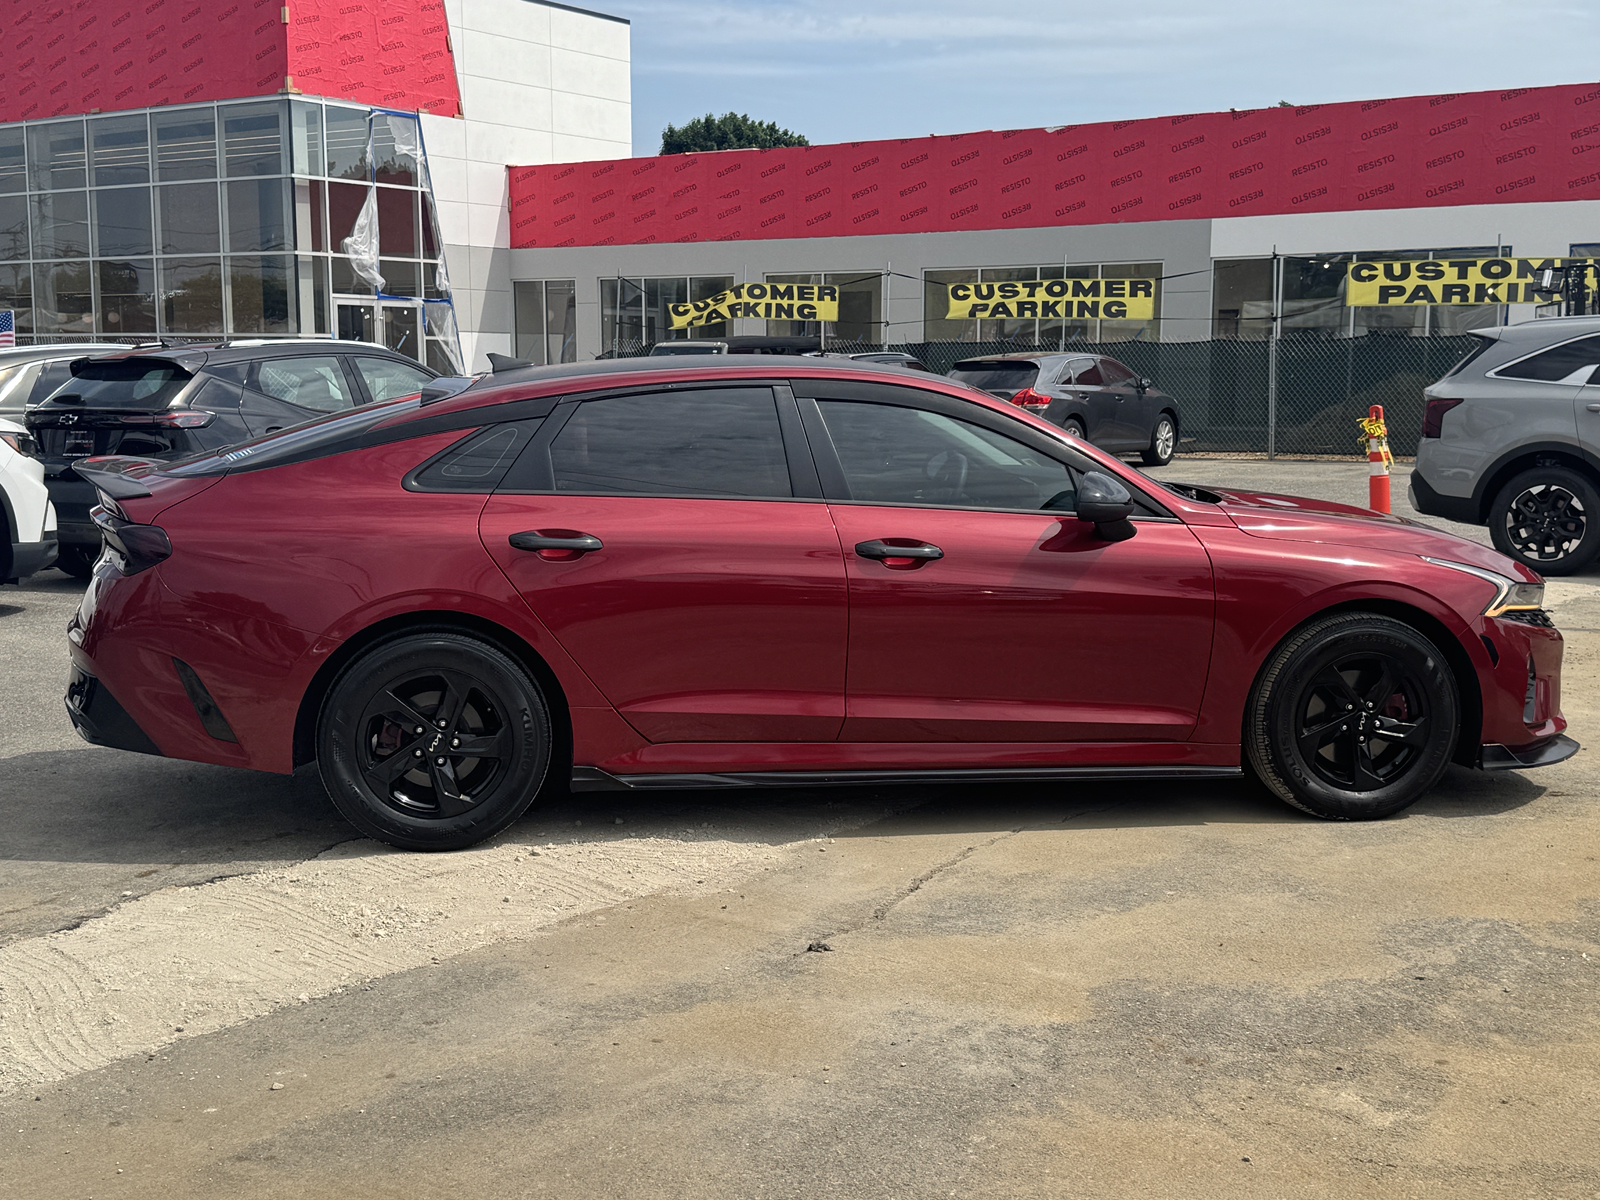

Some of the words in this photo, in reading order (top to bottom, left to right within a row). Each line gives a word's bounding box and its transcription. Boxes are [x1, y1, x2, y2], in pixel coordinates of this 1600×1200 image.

[254, 19, 276, 36] RESISTO
[296, 15, 320, 25] RESISTO
[256, 71, 278, 88] RESISTO
[297, 66, 321, 77] RESISTO
[424, 99, 445, 109] RESISTO
[1430, 117, 1468, 136] RESISTO
[1500, 113, 1540, 131] RESISTO
[1296, 127, 1331, 145] RESISTO
[1361, 122, 1398, 140] RESISTO
[1172, 136, 1204, 153] RESISTO
[1232, 131, 1266, 148] RESISTO
[1003, 148, 1032, 165] RESISTO
[1057, 145, 1088, 162] RESISTO
[1114, 140, 1145, 158] RESISTO
[1496, 146, 1536, 164] RESISTO
[674, 158, 698, 173] RESISTO
[853, 157, 879, 172] RESISTO
[901, 153, 928, 169] RESISTO
[952, 150, 979, 166] RESISTO
[1358, 155, 1395, 173] RESISTO
[1426, 150, 1464, 168] RESISTO
[554, 168, 574, 180] RESISTO
[593, 164, 614, 178] RESISTO
[633, 161, 656, 177] RESISTO
[717, 164, 741, 177] RESISTO
[761, 164, 785, 178] RESISTO
[806, 160, 831, 176] RESISTO
[1169, 166, 1201, 183] RESISTO
[1230, 162, 1263, 180] RESISTO
[1292, 159, 1328, 176] RESISTO
[514, 169, 537, 184] RESISTO
[1055, 174, 1085, 191] RESISTO
[1111, 171, 1142, 188] RESISTO
[674, 184, 697, 198] RESISTO
[852, 184, 878, 200] RESISTO
[900, 182, 927, 197] RESISTO
[950, 179, 977, 195] RESISTO
[1002, 178, 1030, 194] RESISTO
[1358, 183, 1395, 201] RESISTO
[1426, 180, 1464, 198] RESISTO
[1496, 176, 1536, 194] RESISTO
[514, 193, 536, 207] RESISTO
[554, 192, 574, 205] RESISTO
[592, 190, 614, 203] RESISTO
[632, 187, 654, 201] RESISTO
[760, 190, 784, 204] RESISTO
[806, 188, 830, 202] RESISTO
[1169, 194, 1201, 210] RESISTO
[1230, 190, 1264, 207] RESISTO
[1292, 187, 1327, 204] RESISTO
[718, 206, 741, 219] RESISTO
[951, 204, 978, 220] RESISTO
[1002, 204, 1031, 219] RESISTO
[1056, 201, 1086, 216] RESISTO
[1111, 197, 1143, 214] RESISTO
[515, 215, 537, 229] RESISTO
[554, 214, 575, 227] RESISTO
[593, 212, 615, 224] RESISTO
[634, 210, 656, 223] RESISTO
[676, 208, 698, 220] RESISTO
[761, 214, 785, 228] RESISTO
[807, 212, 832, 226] RESISTO
[853, 209, 879, 224] RESISTO
[901, 207, 928, 221] RESISTO
[950, 280, 1153, 301] CUSTOMER
[671, 283, 838, 317] CUSTOMER
[968, 300, 1128, 318] PARKING
[520, 706, 533, 774] KUMHO
[1281, 736, 1310, 788] SOLUS
